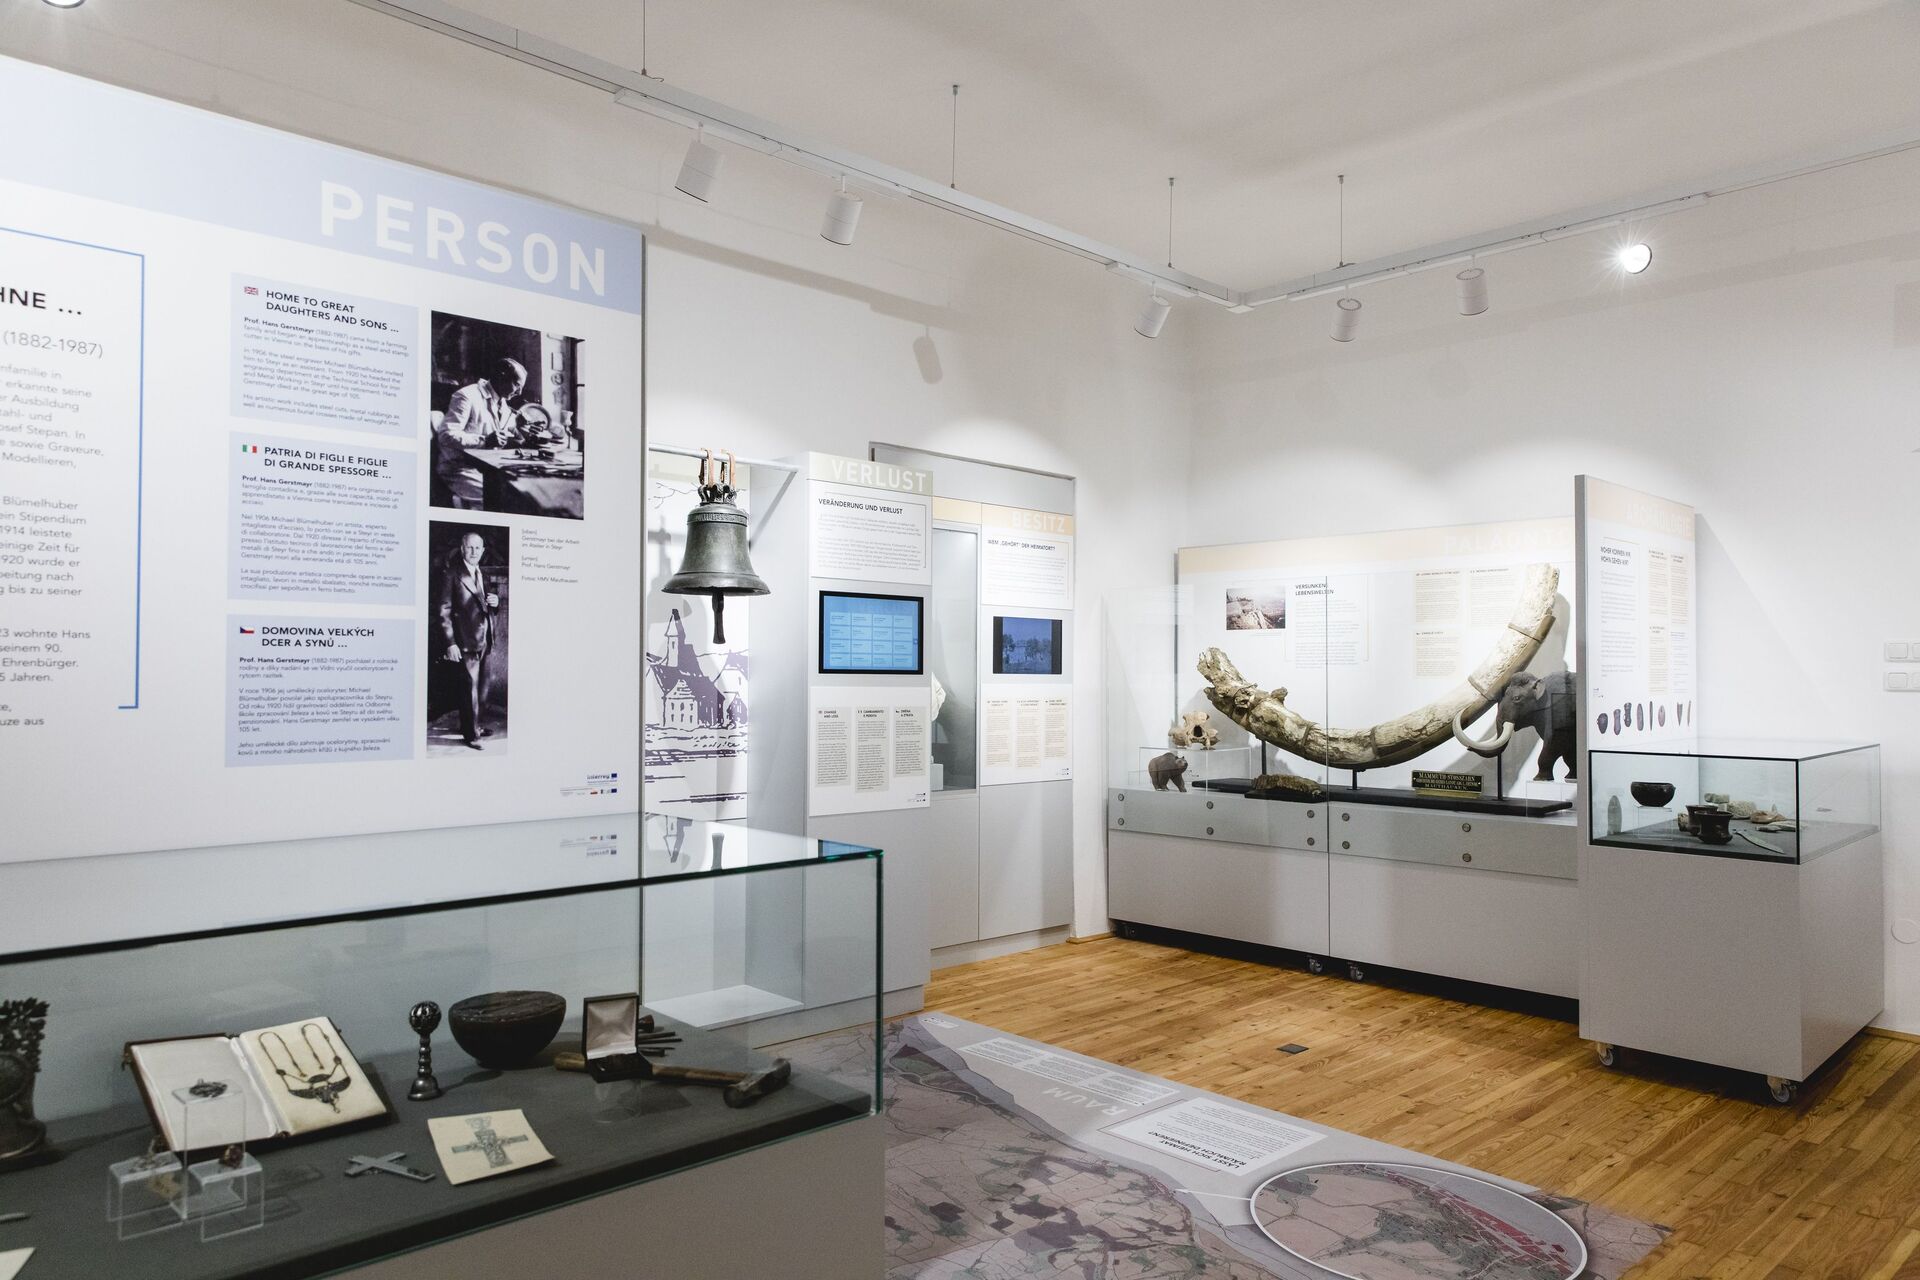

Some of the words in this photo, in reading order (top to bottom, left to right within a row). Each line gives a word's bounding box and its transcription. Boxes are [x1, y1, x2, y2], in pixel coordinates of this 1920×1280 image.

[321, 180, 605, 297] PERSON
[0, 286, 46, 309] NE
[266, 290, 300, 304] HOME
[303, 297, 318, 307] TO
[321, 300, 354, 313] GREAT
[266, 302, 332, 321] DAUGHTERS
[335, 314, 357, 325] AND
[359, 318, 388, 330] SONS
[244, 316, 260, 325] Prof.
[262, 319, 279, 328] Hans
[280, 322, 314, 335] Gerstmayr
[3, 330, 104, 359] (1882-1987)
[51, 370, 62, 380] in
[6, 379, 58, 394] erkannte
[62, 387, 92, 398] seine
[11, 393, 79, 414] Ausbildung
[29, 410, 52, 422] und
[26, 424, 72, 441] Stepan.
[75, 430, 86, 440] In
[10, 438, 45, 450] sowie
[48, 441, 105, 457] Graveure,
[2, 452, 77, 470] Modellieren,
[264, 447, 303, 458] PATRIA
[305, 451, 316, 460] DI
[319, 453, 345, 463] FIGLI
[348, 456, 355, 464] E
[358, 457, 388, 467] FIGLIE
[264, 458, 276, 467] DI
[279, 460, 325, 472] GRANDE
[328, 465, 380, 478] SPESSORE
[831, 459, 926, 492] VERLUST
[242, 474, 259, 482] Prof.
[260, 476, 277, 484] Hans
[278, 477, 312, 488] Gerstmayr
[2, 495, 79, 511] Blümelhuber
[818, 498, 864, 510] VERÄNDERUNG
[865, 504, 878, 512] UND
[879, 506, 903, 514] VERLUST
[19, 510, 87, 527] Stipendium
[1011, 511, 1065, 532] BESITZ
[29, 526, 73, 539] leistete
[38, 542, 61, 553] Zeit
[64, 543, 81, 554] für
[27, 555, 65, 567] wurde
[68, 560, 81, 568] er
[46, 571, 74, 582] nach
[8, 584, 26, 594] bis
[30, 587, 44, 595] zu
[47, 586, 83, 596] seiner
[14, 629, 58, 639] wohnte
[62, 629, 91, 639] Hans
[262, 627, 324, 636] DOMOVINA
[328, 627, 375, 637] VELKÝCH
[44, 643, 63, 653] 90.
[262, 639, 291, 647] DCER
[294, 639, 303, 647] A
[305, 638, 336, 647] SYNŮ
[2, 657, 80, 670] Ehrenbürger.
[276, 657, 310, 665] Gerstmayr
[10, 672, 54, 682] Jahren.
[24, 718, 45, 726] aus
[1042, 1087, 1128, 1116] RAUM
[1160, 1139, 1191, 1153] HEIMAT
[1193, 1151, 1212, 1160] SICH
[1202, 1148, 1247, 1166] RÄUMLICH
